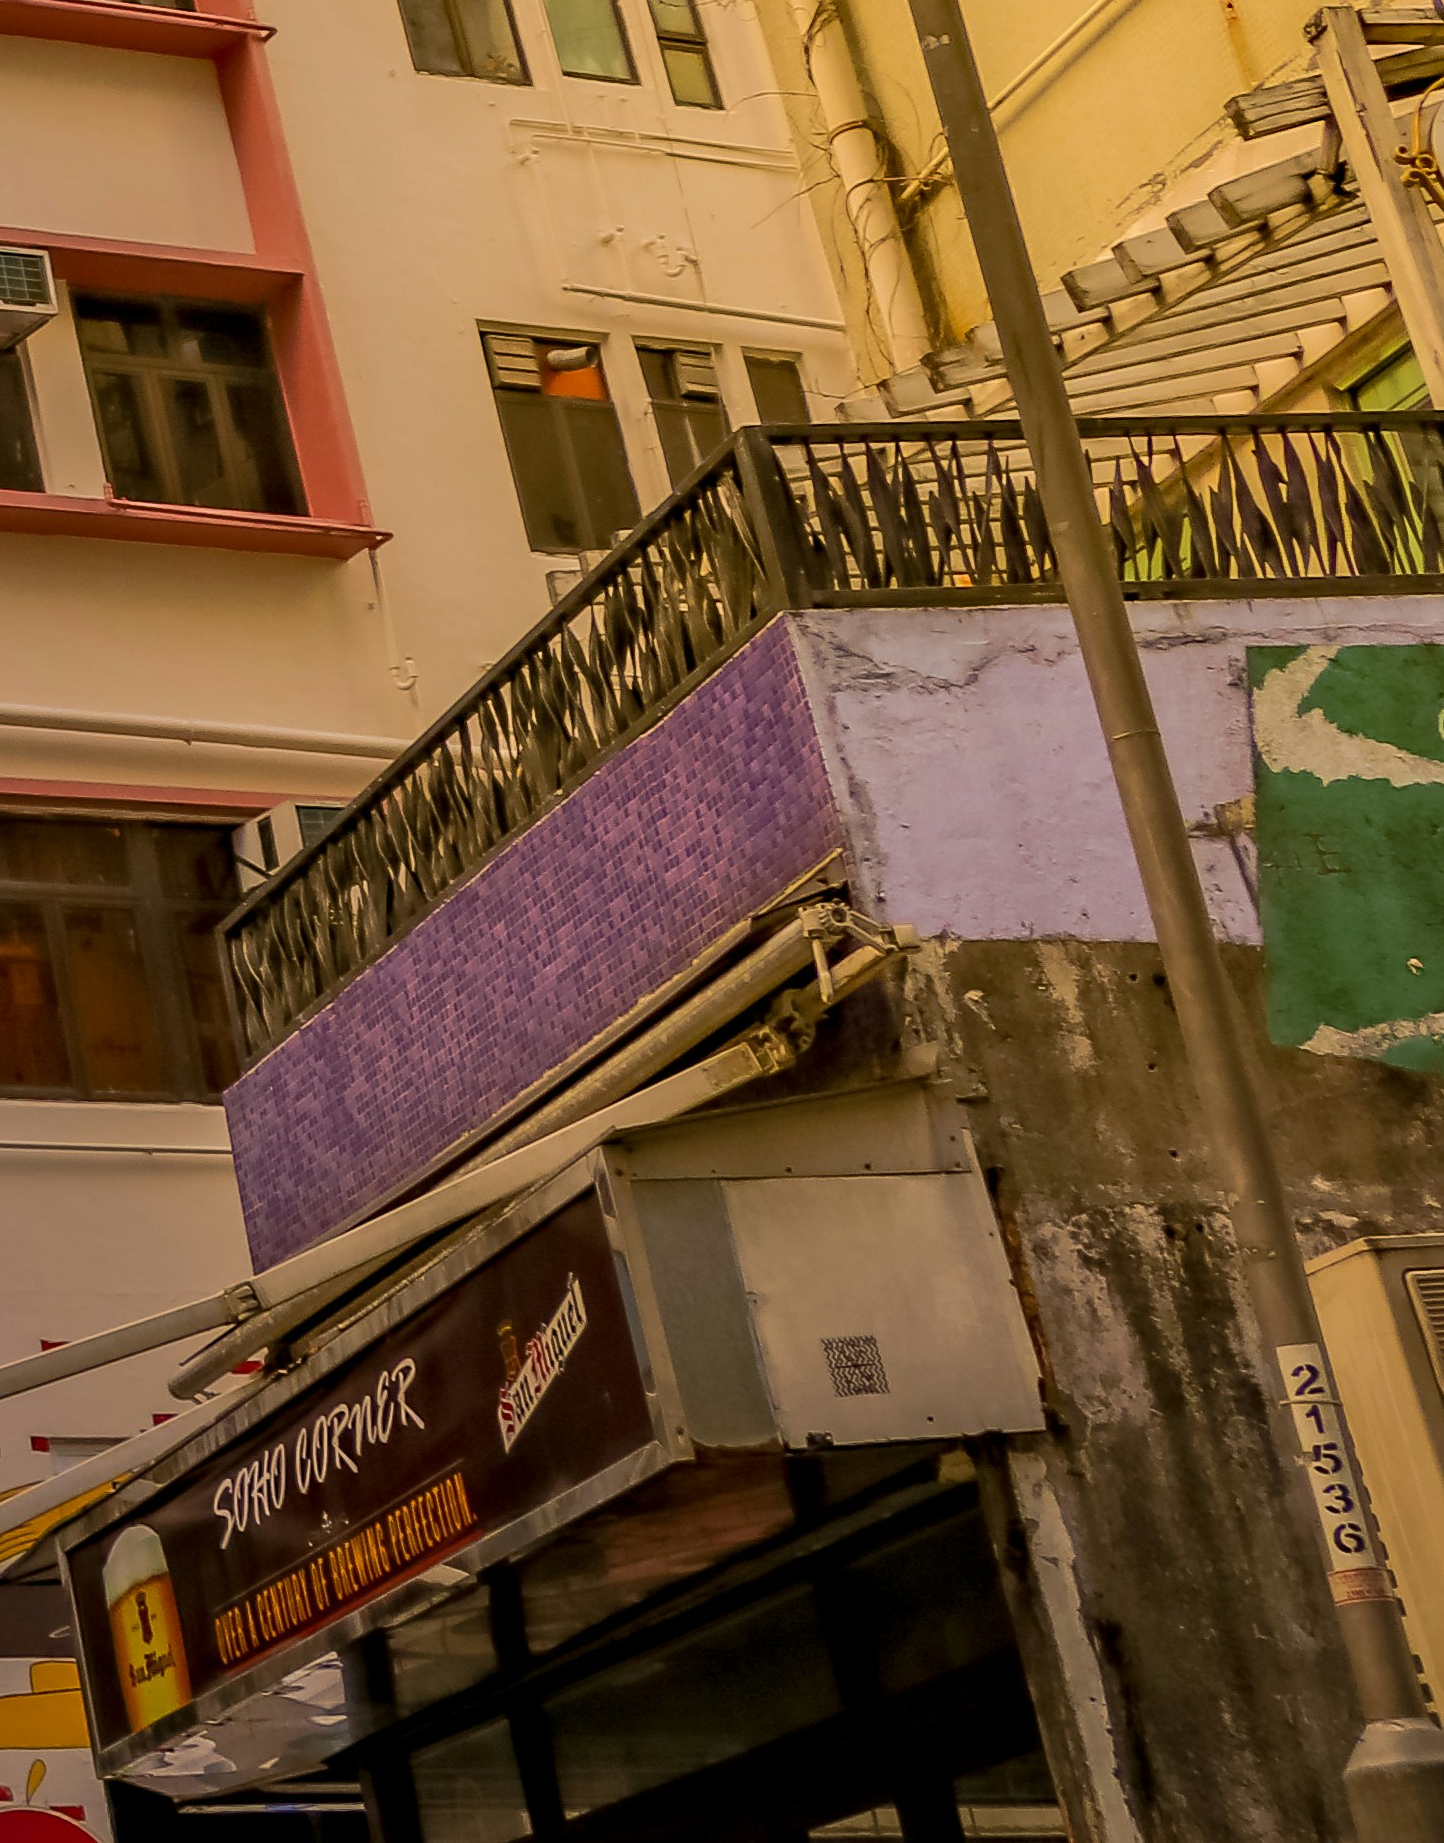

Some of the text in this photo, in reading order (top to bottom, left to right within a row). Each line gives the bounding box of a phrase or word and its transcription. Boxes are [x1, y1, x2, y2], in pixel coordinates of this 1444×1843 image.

[213, 1357, 425, 1550] SOHO CORNER
[1290, 1363, 1366, 1554] 21536
[216, 1607, 249, 1665] OVER
[246, 1600, 260, 1648] A
[256, 1568, 313, 1642] CENTURY
[310, 1557, 331, 1612] OF
[328, 1521, 392, 1602] BREWING
